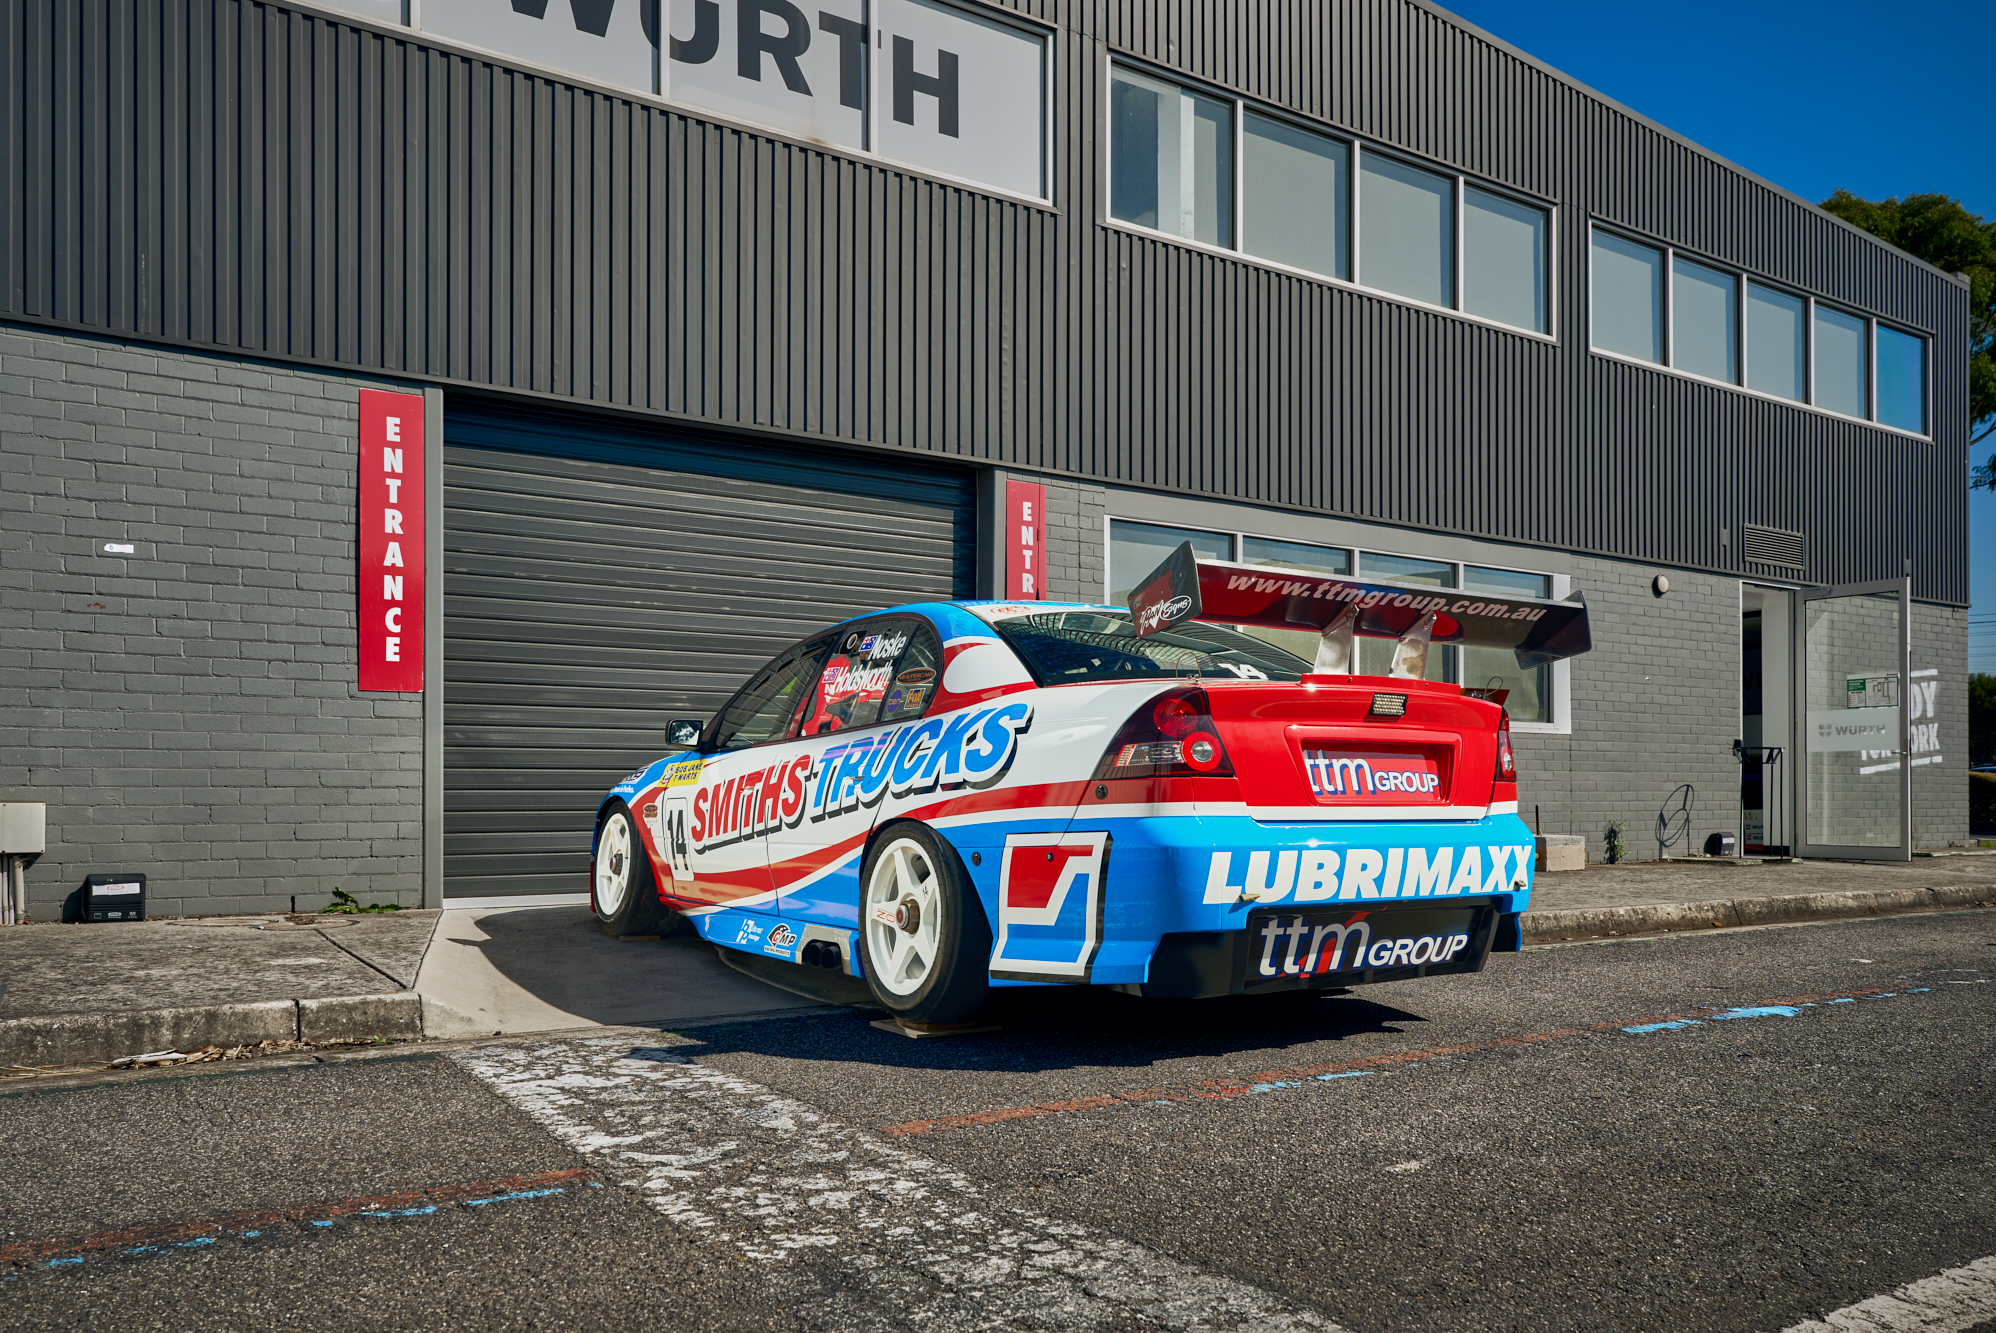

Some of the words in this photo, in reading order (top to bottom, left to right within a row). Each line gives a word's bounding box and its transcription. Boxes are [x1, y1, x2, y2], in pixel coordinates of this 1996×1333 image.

[383, 416, 404, 662] ENTRANCE
[1162, 599, 1189, 617] Signs
[1227, 574, 1547, 623] www.ttmgroup.com.au
[868, 631, 907, 660] Noske
[834, 660, 894, 692] Holdsworth
[1217, 663, 1269, 680] 14
[1836, 724, 1886, 736] WÜRTH
[675, 765, 688, 774] BOB
[688, 763, 703, 772] JANE
[690, 754, 814, 848] SMITHS
[813, 703, 1031, 816] TRUCKS
[667, 809, 689, 871] 14
[1203, 846, 1533, 904] LUBRIMAXX
